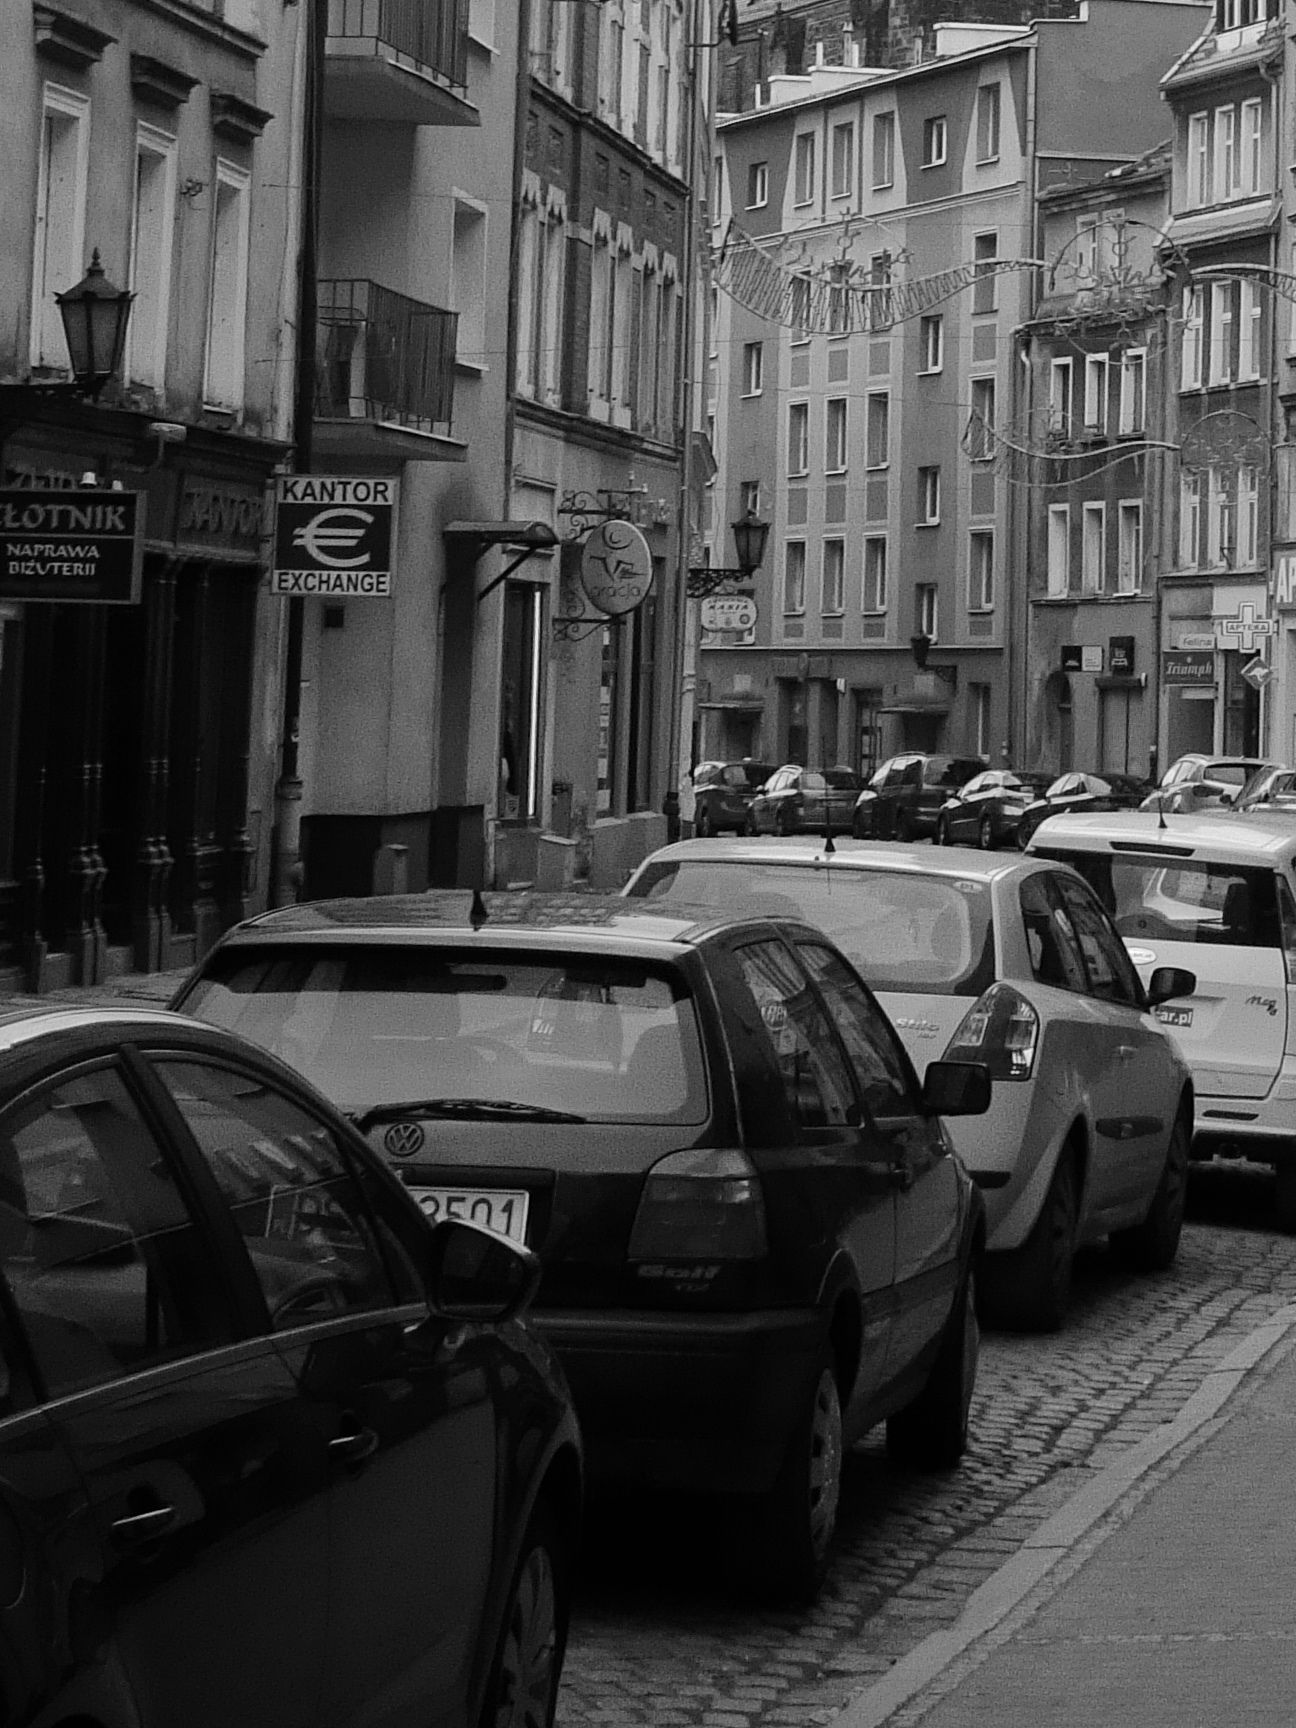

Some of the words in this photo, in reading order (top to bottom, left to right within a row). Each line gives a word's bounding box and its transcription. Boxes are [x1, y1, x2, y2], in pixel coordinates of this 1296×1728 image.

[282, 480, 389, 503] KANTOR
[0, 503, 125, 530] ŁOTNIK
[6, 543, 100, 559] NAPRAWA
[277, 571, 388, 593] EXCHANGE
[1228, 623, 1267, 632] APTEKA
[1165, 661, 1213, 678] Triumph
[1155, 1010, 1193, 1025] ar.pl
